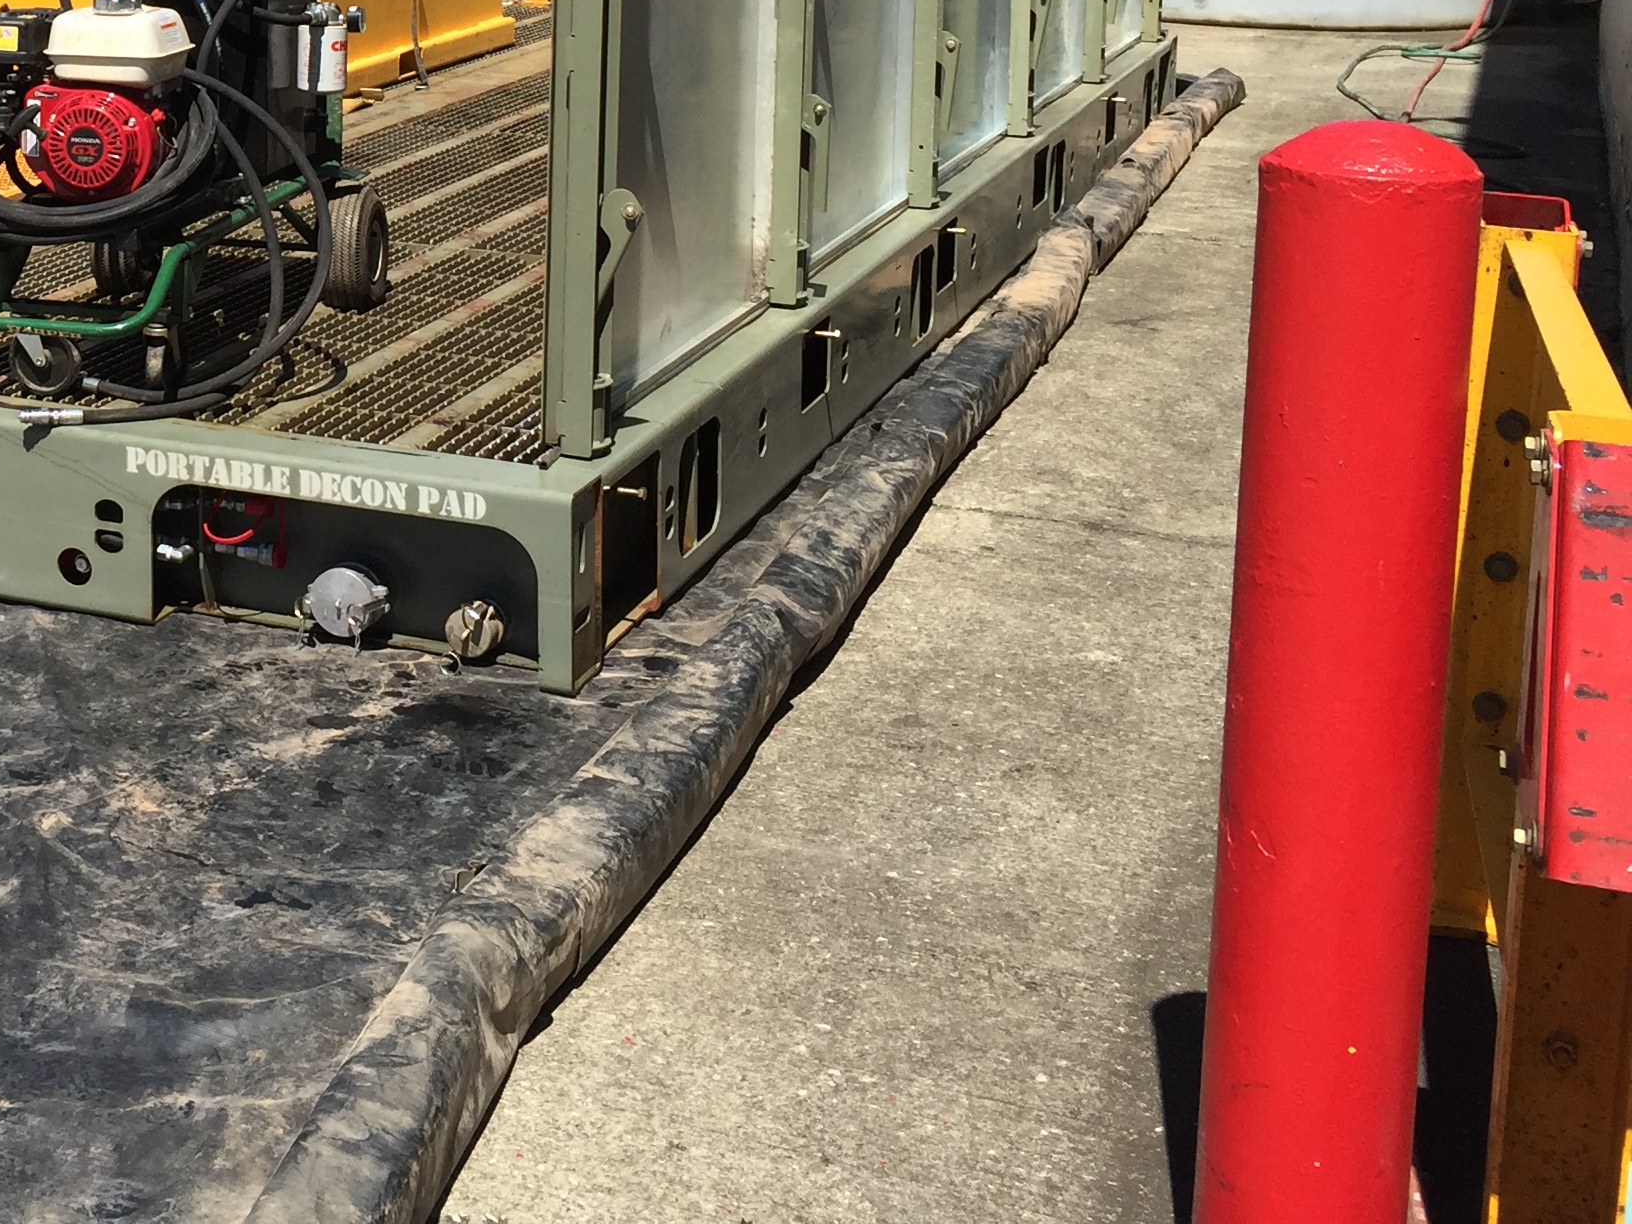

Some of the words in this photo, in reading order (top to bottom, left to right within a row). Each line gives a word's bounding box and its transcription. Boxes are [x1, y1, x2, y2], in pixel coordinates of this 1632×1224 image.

[70, 137, 101, 145] HONDA
[71, 144, 99, 156] GX
[125, 446, 291, 495] PORTABLE
[298, 468, 409, 511] DECON
[417, 485, 487, 521] PAD
